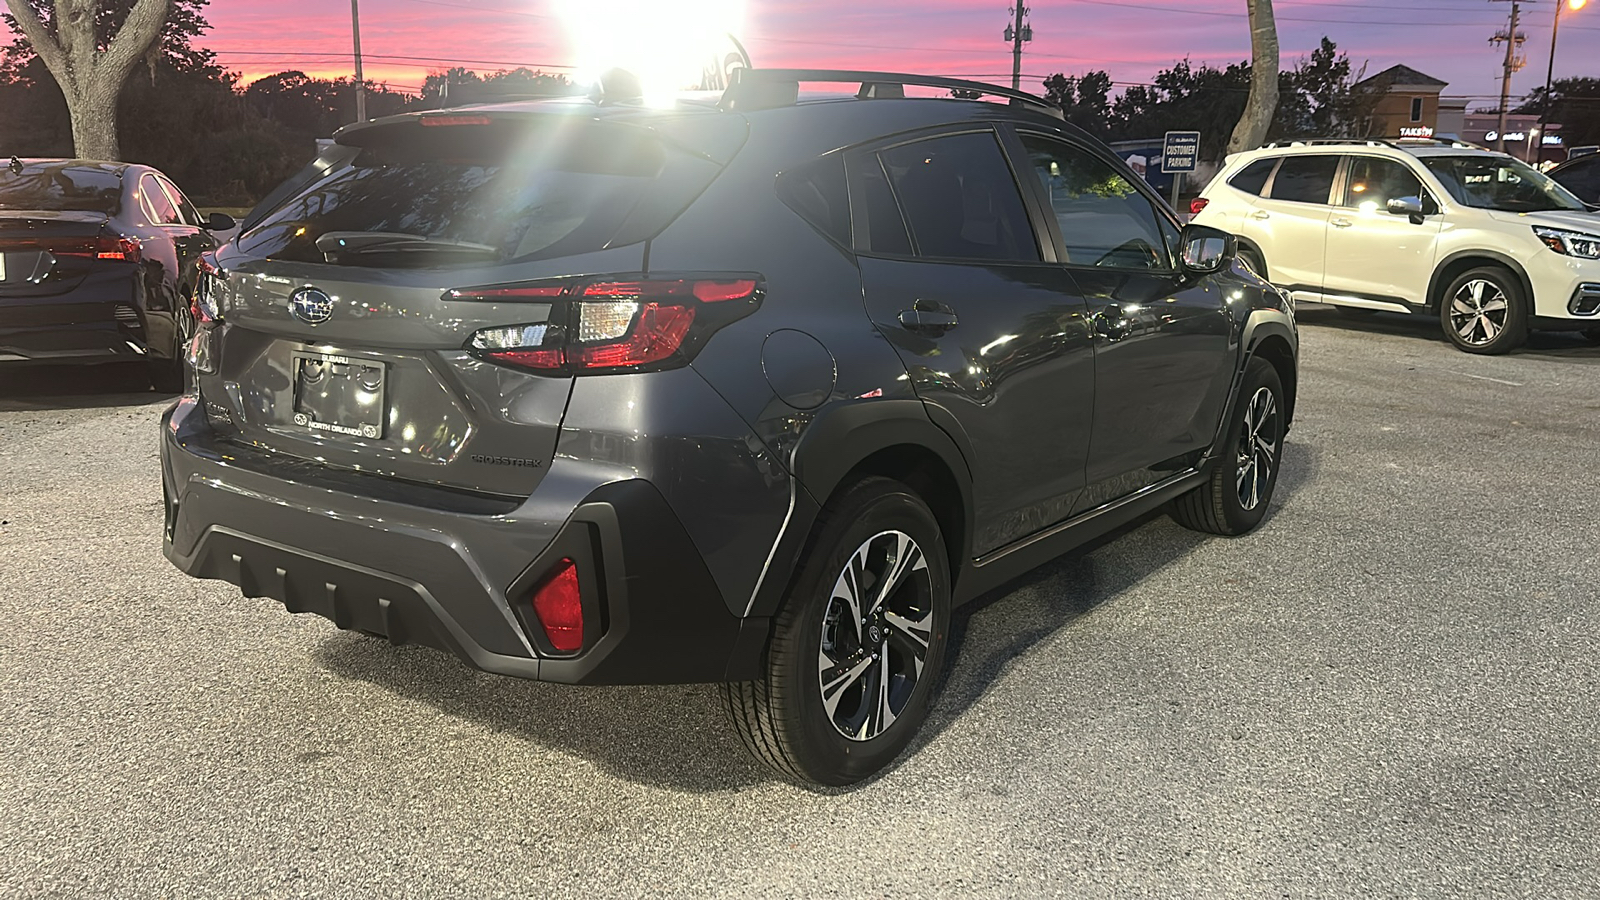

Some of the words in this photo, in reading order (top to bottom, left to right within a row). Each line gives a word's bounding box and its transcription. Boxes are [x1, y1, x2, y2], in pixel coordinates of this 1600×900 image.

[1166, 145, 1196, 155] CUSTOMER
[1167, 157, 1192, 167] PARKING
[321, 354, 349, 364] SUBARU
[308, 421, 331, 431] NORTH
[331, 425, 363, 436] ORLANDO
[470, 454, 542, 468] CROSSTREK
